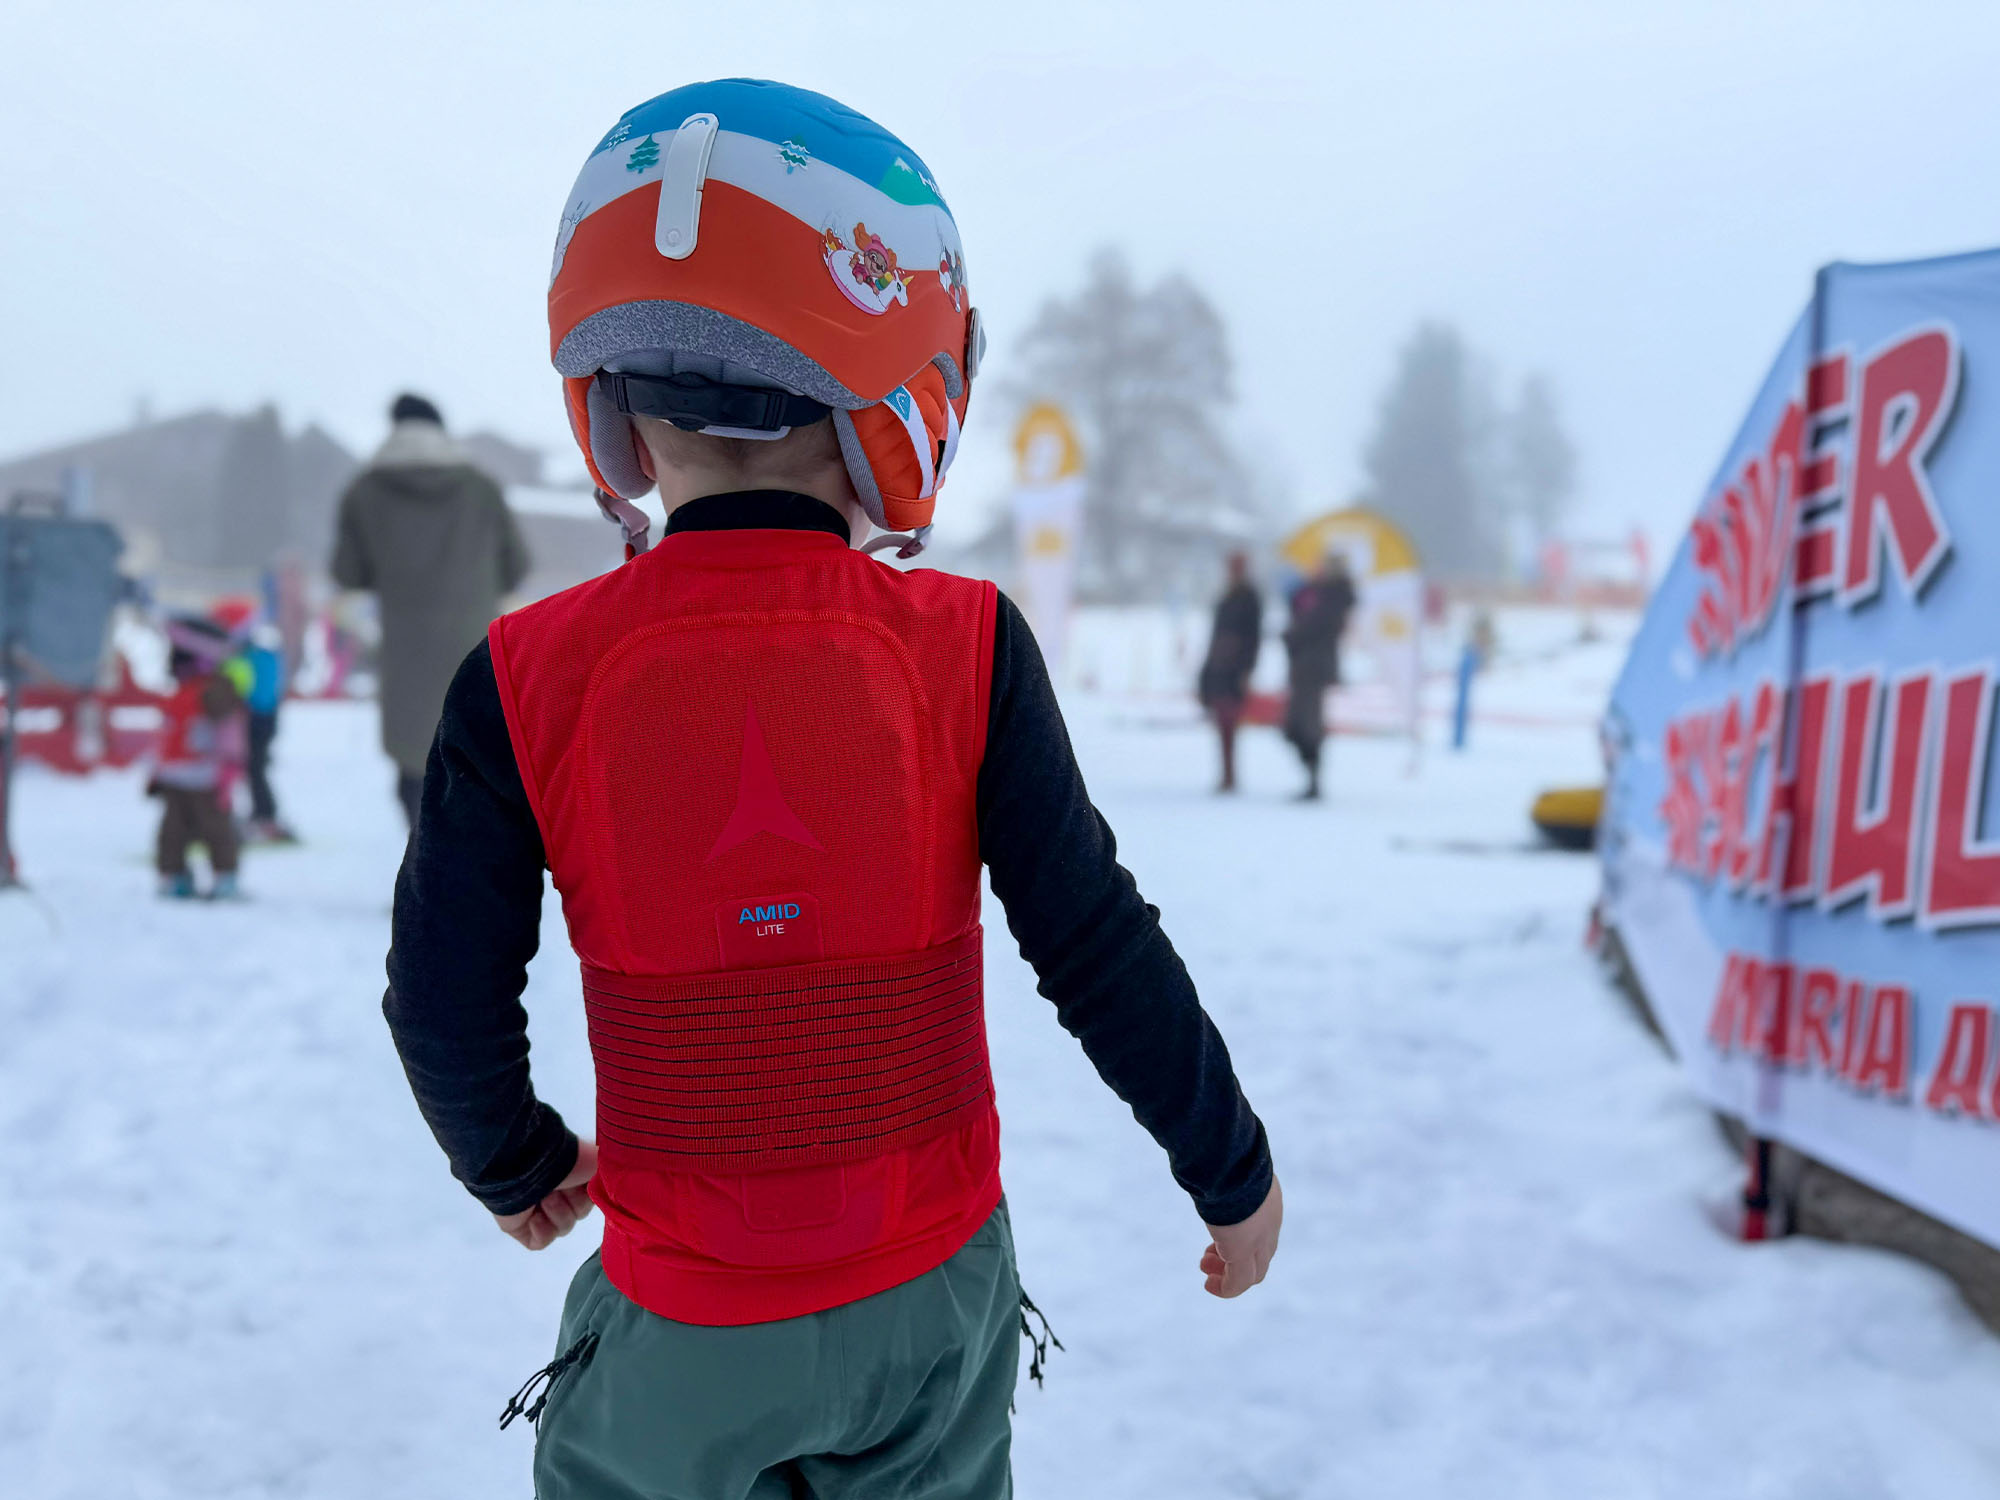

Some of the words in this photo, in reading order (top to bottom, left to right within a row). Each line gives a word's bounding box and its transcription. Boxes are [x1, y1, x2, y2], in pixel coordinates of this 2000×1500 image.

[739, 903, 801, 924] AMID
[756, 923, 785, 937] LITE
[1925, 1003, 2000, 1122] A
